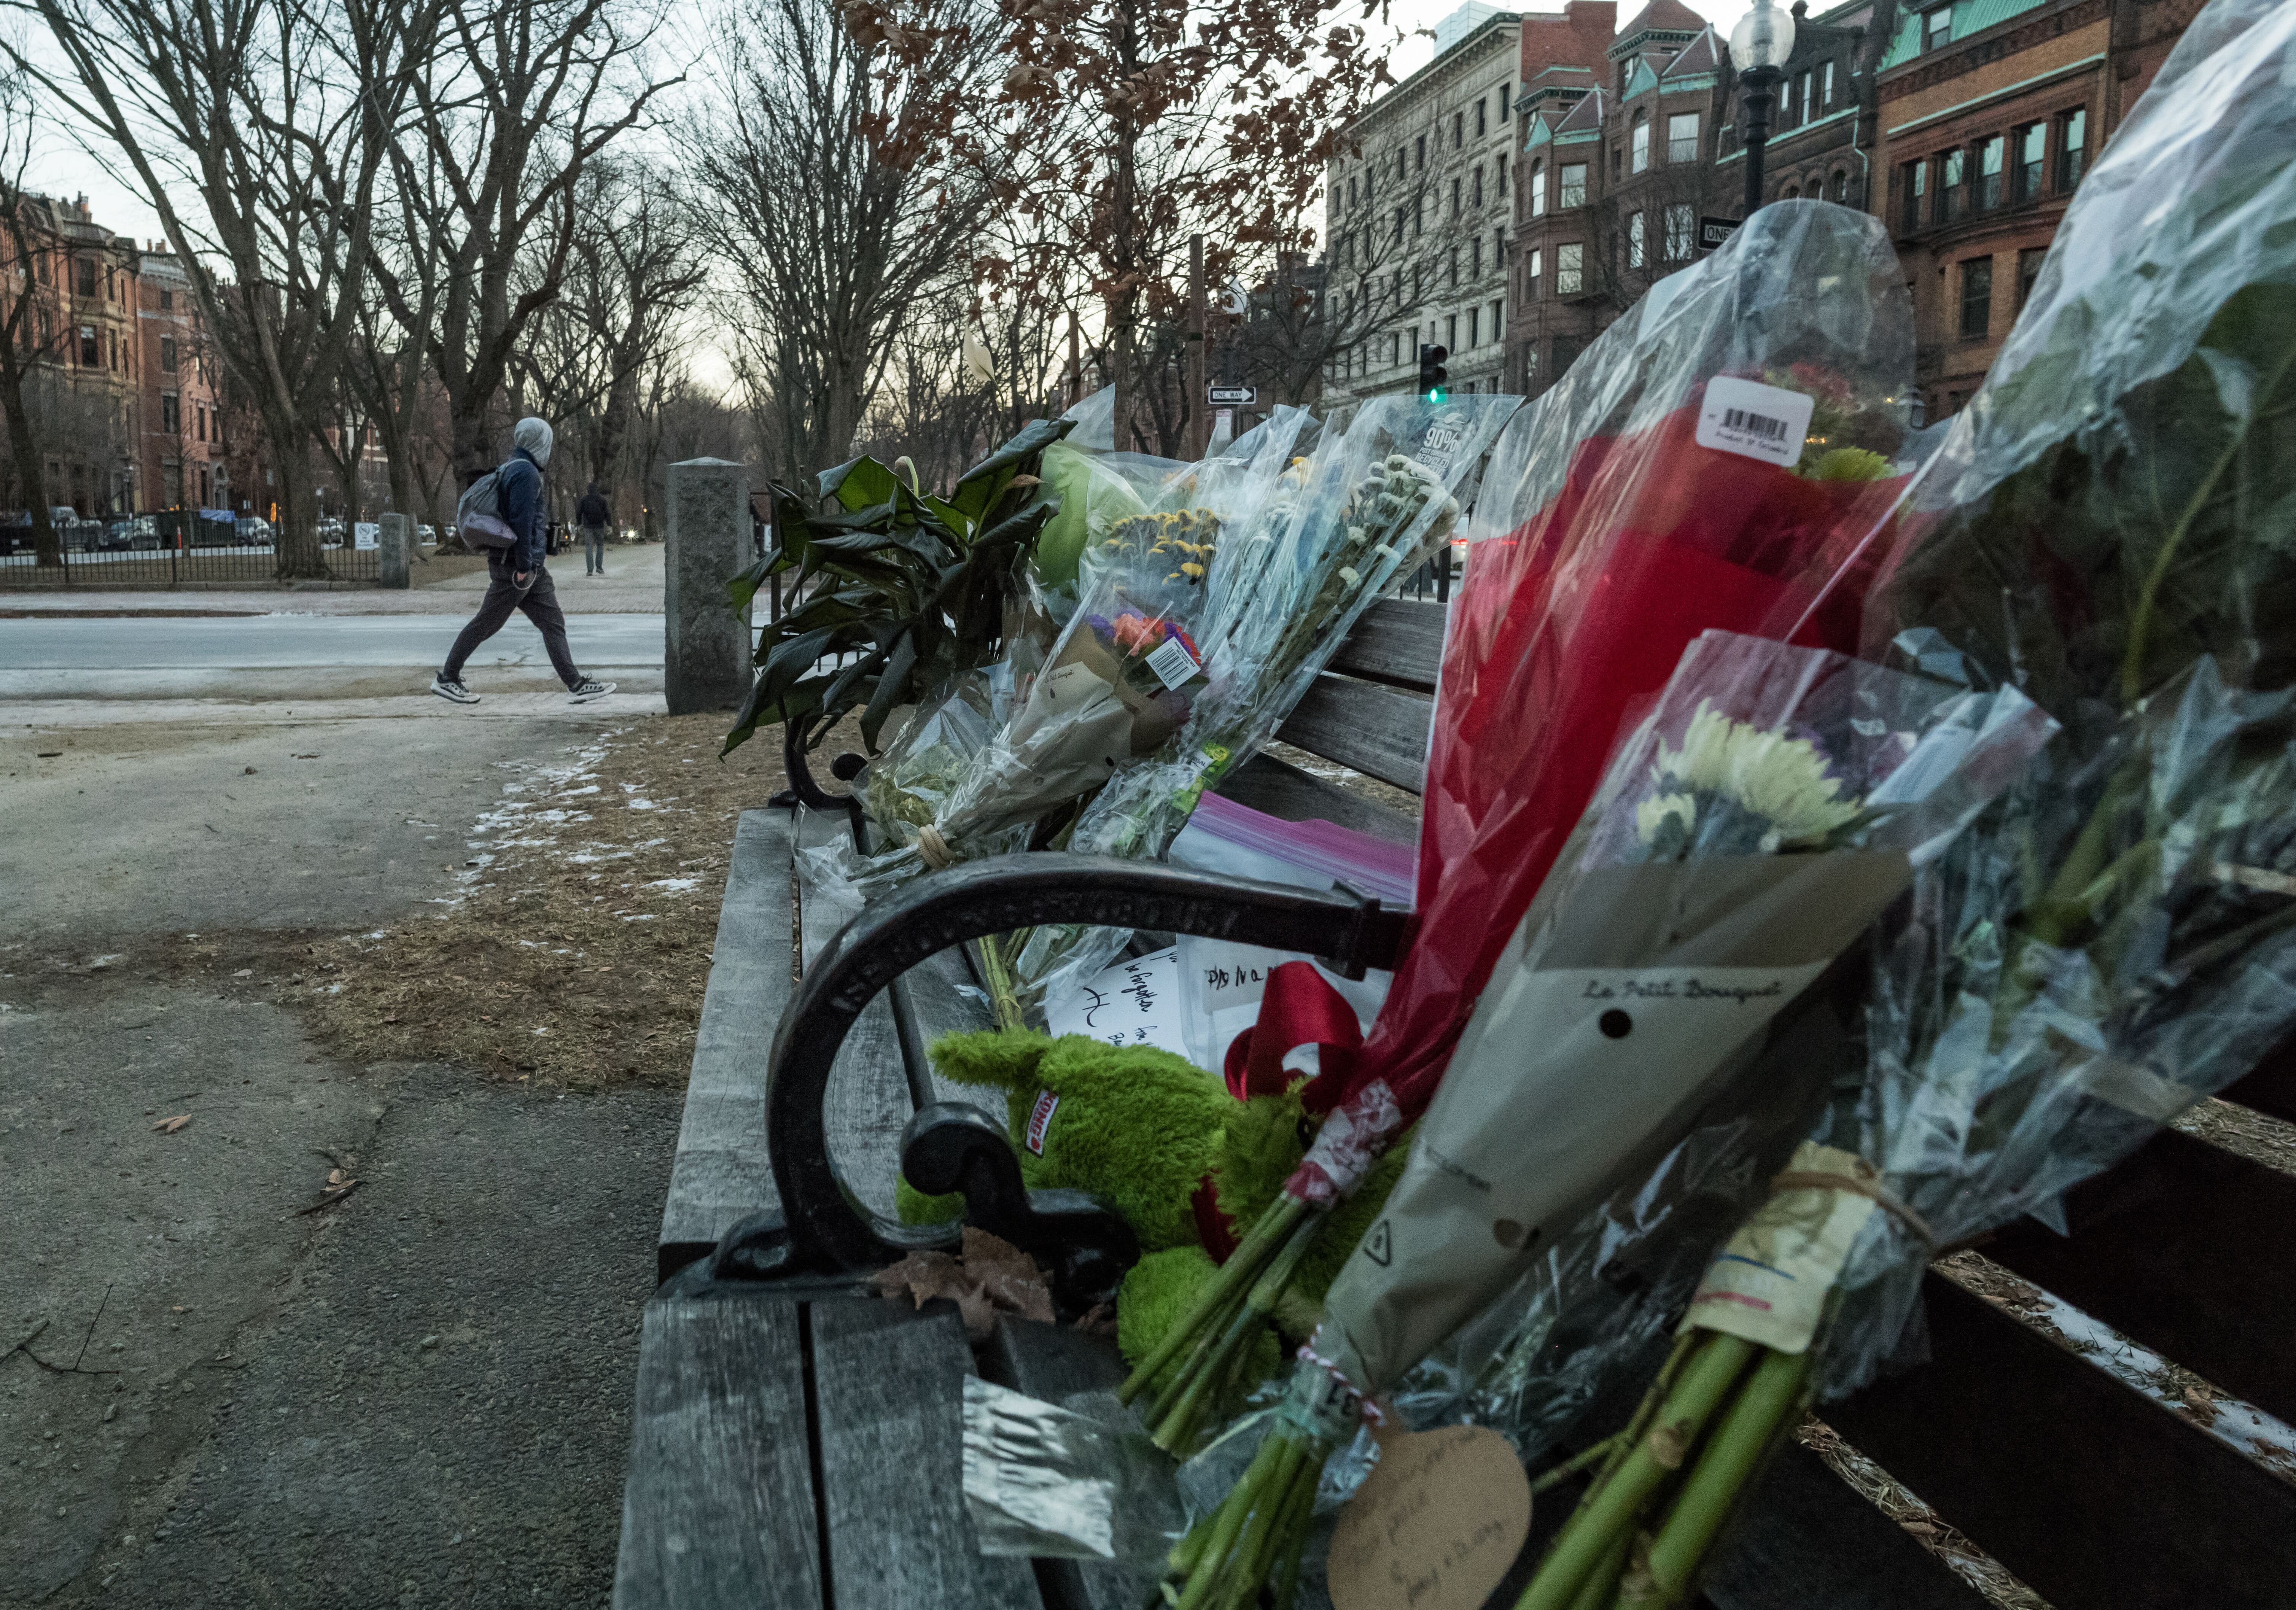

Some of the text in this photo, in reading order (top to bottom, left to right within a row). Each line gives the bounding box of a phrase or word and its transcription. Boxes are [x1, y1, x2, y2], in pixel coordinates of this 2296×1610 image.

[1707, 226, 1731, 240] ONE
[1424, 427, 1458, 452] 90%
[1415, 453, 1450, 468] RECYCLED
[1430, 448, 1453, 459] CONSUMER
[1181, 649, 1191, 661] Seasonal
[1057, 670, 1074, 679] Bouquet
[1121, 972, 1158, 1012] forgotten
[1582, 978, 1781, 1005] Le Petit Bouquet
